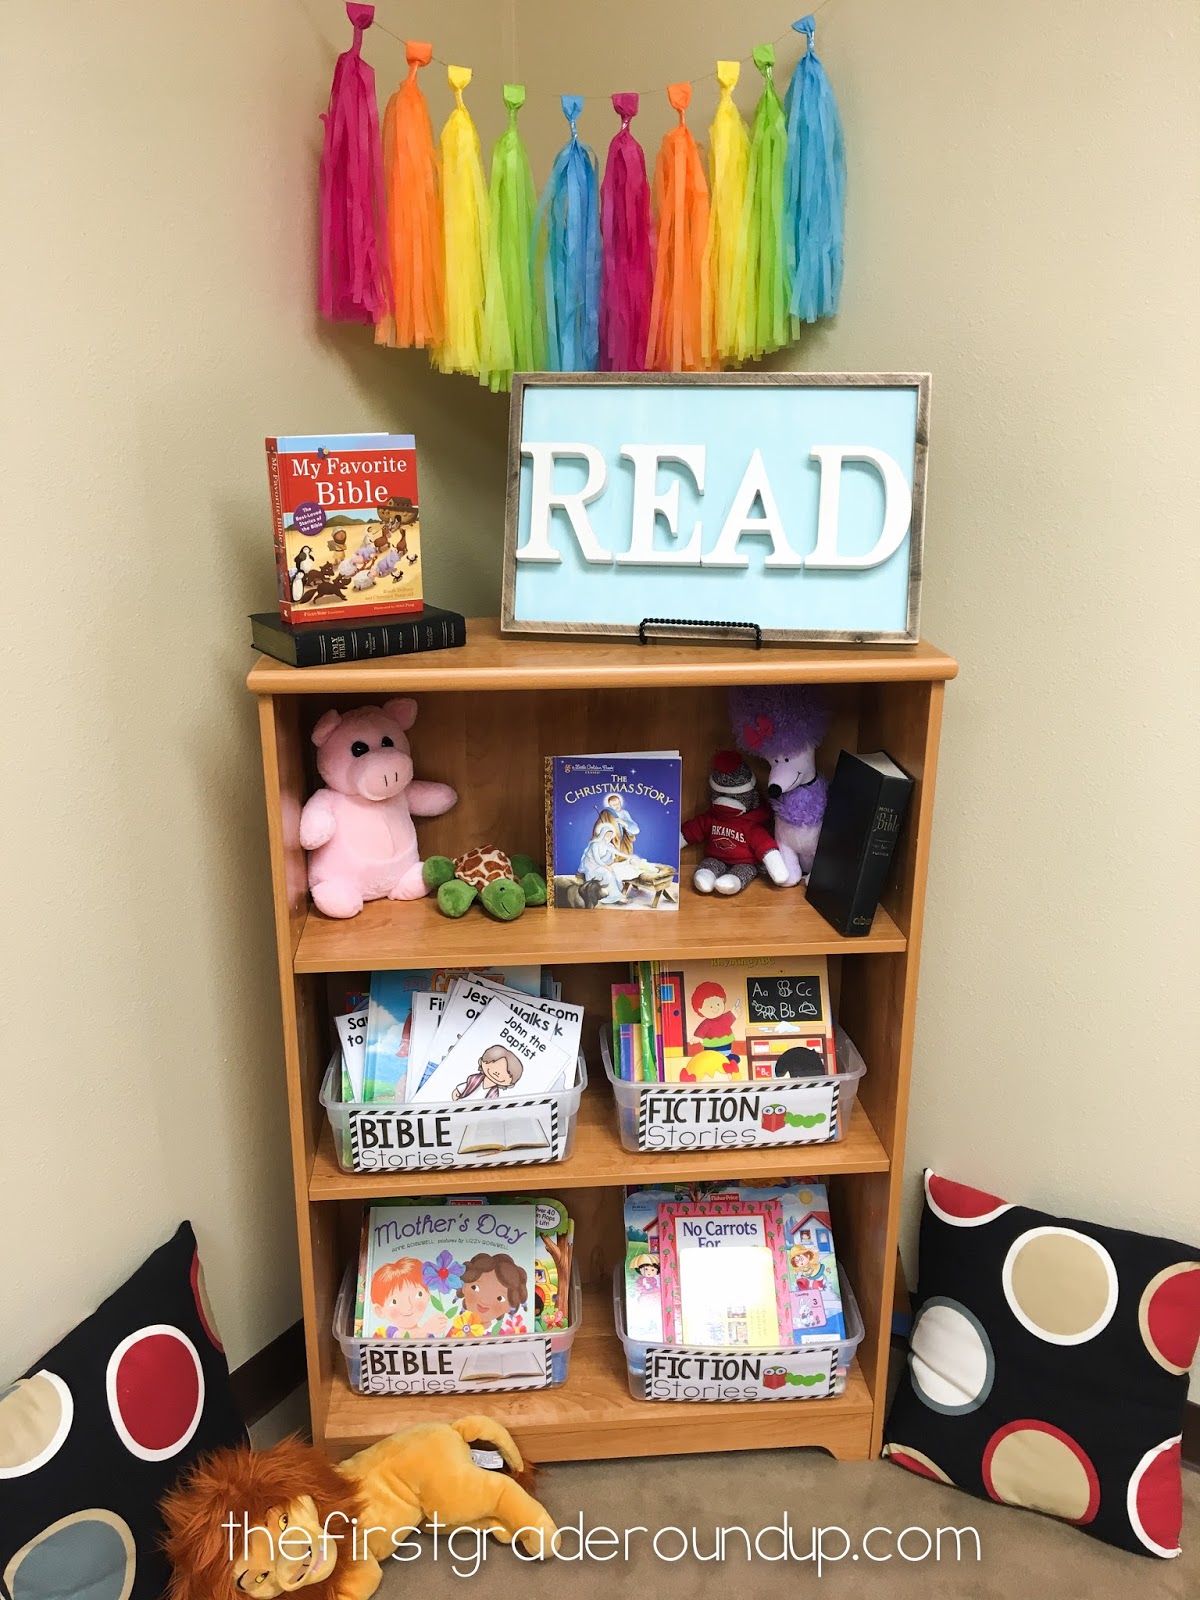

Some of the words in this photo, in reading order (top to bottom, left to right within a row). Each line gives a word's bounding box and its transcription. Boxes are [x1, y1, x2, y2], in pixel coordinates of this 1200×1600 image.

[291, 458, 322, 480] My
[326, 456, 408, 475] Favorite
[315, 480, 389, 506] Bible
[295, 509, 323, 522] Best-Loved
[516, 441, 912, 570] READ
[298, 518, 317, 527] Stories
[310, 522, 324, 530] Bible
[331, 636, 339, 659] HOLY
[338, 635, 346, 659] BIBLE
[610, 774, 628, 783] THE
[564, 783, 635, 804] CHRISTMAS
[635, 783, 674, 806] STORY
[752, 982, 769, 997] Aa
[795, 981, 813, 997] Cc
[779, 1002, 796, 1018] Bb
[347, 1035, 364, 1047] to
[499, 1027, 537, 1061] Baptist
[504, 1016, 529, 1039] John
[529, 1033, 548, 1053] the
[648, 1095, 760, 1124] FICTION
[360, 1116, 453, 1149] BIBLE
[648, 1125, 757, 1146] Stories
[361, 1149, 455, 1167] Stories
[546, 1208, 556, 1216] 40
[374, 1212, 470, 1248] Mother's
[476, 1213, 528, 1245] Day
[683, 1221, 702, 1237] No
[705, 1220, 758, 1236] Carrots
[812, 1298, 818, 1306] 3
[369, 1350, 454, 1375] BIBLE
[654, 1355, 761, 1381] FICTION
[370, 1375, 456, 1391] Stories
[653, 1379, 758, 1398] Stories
